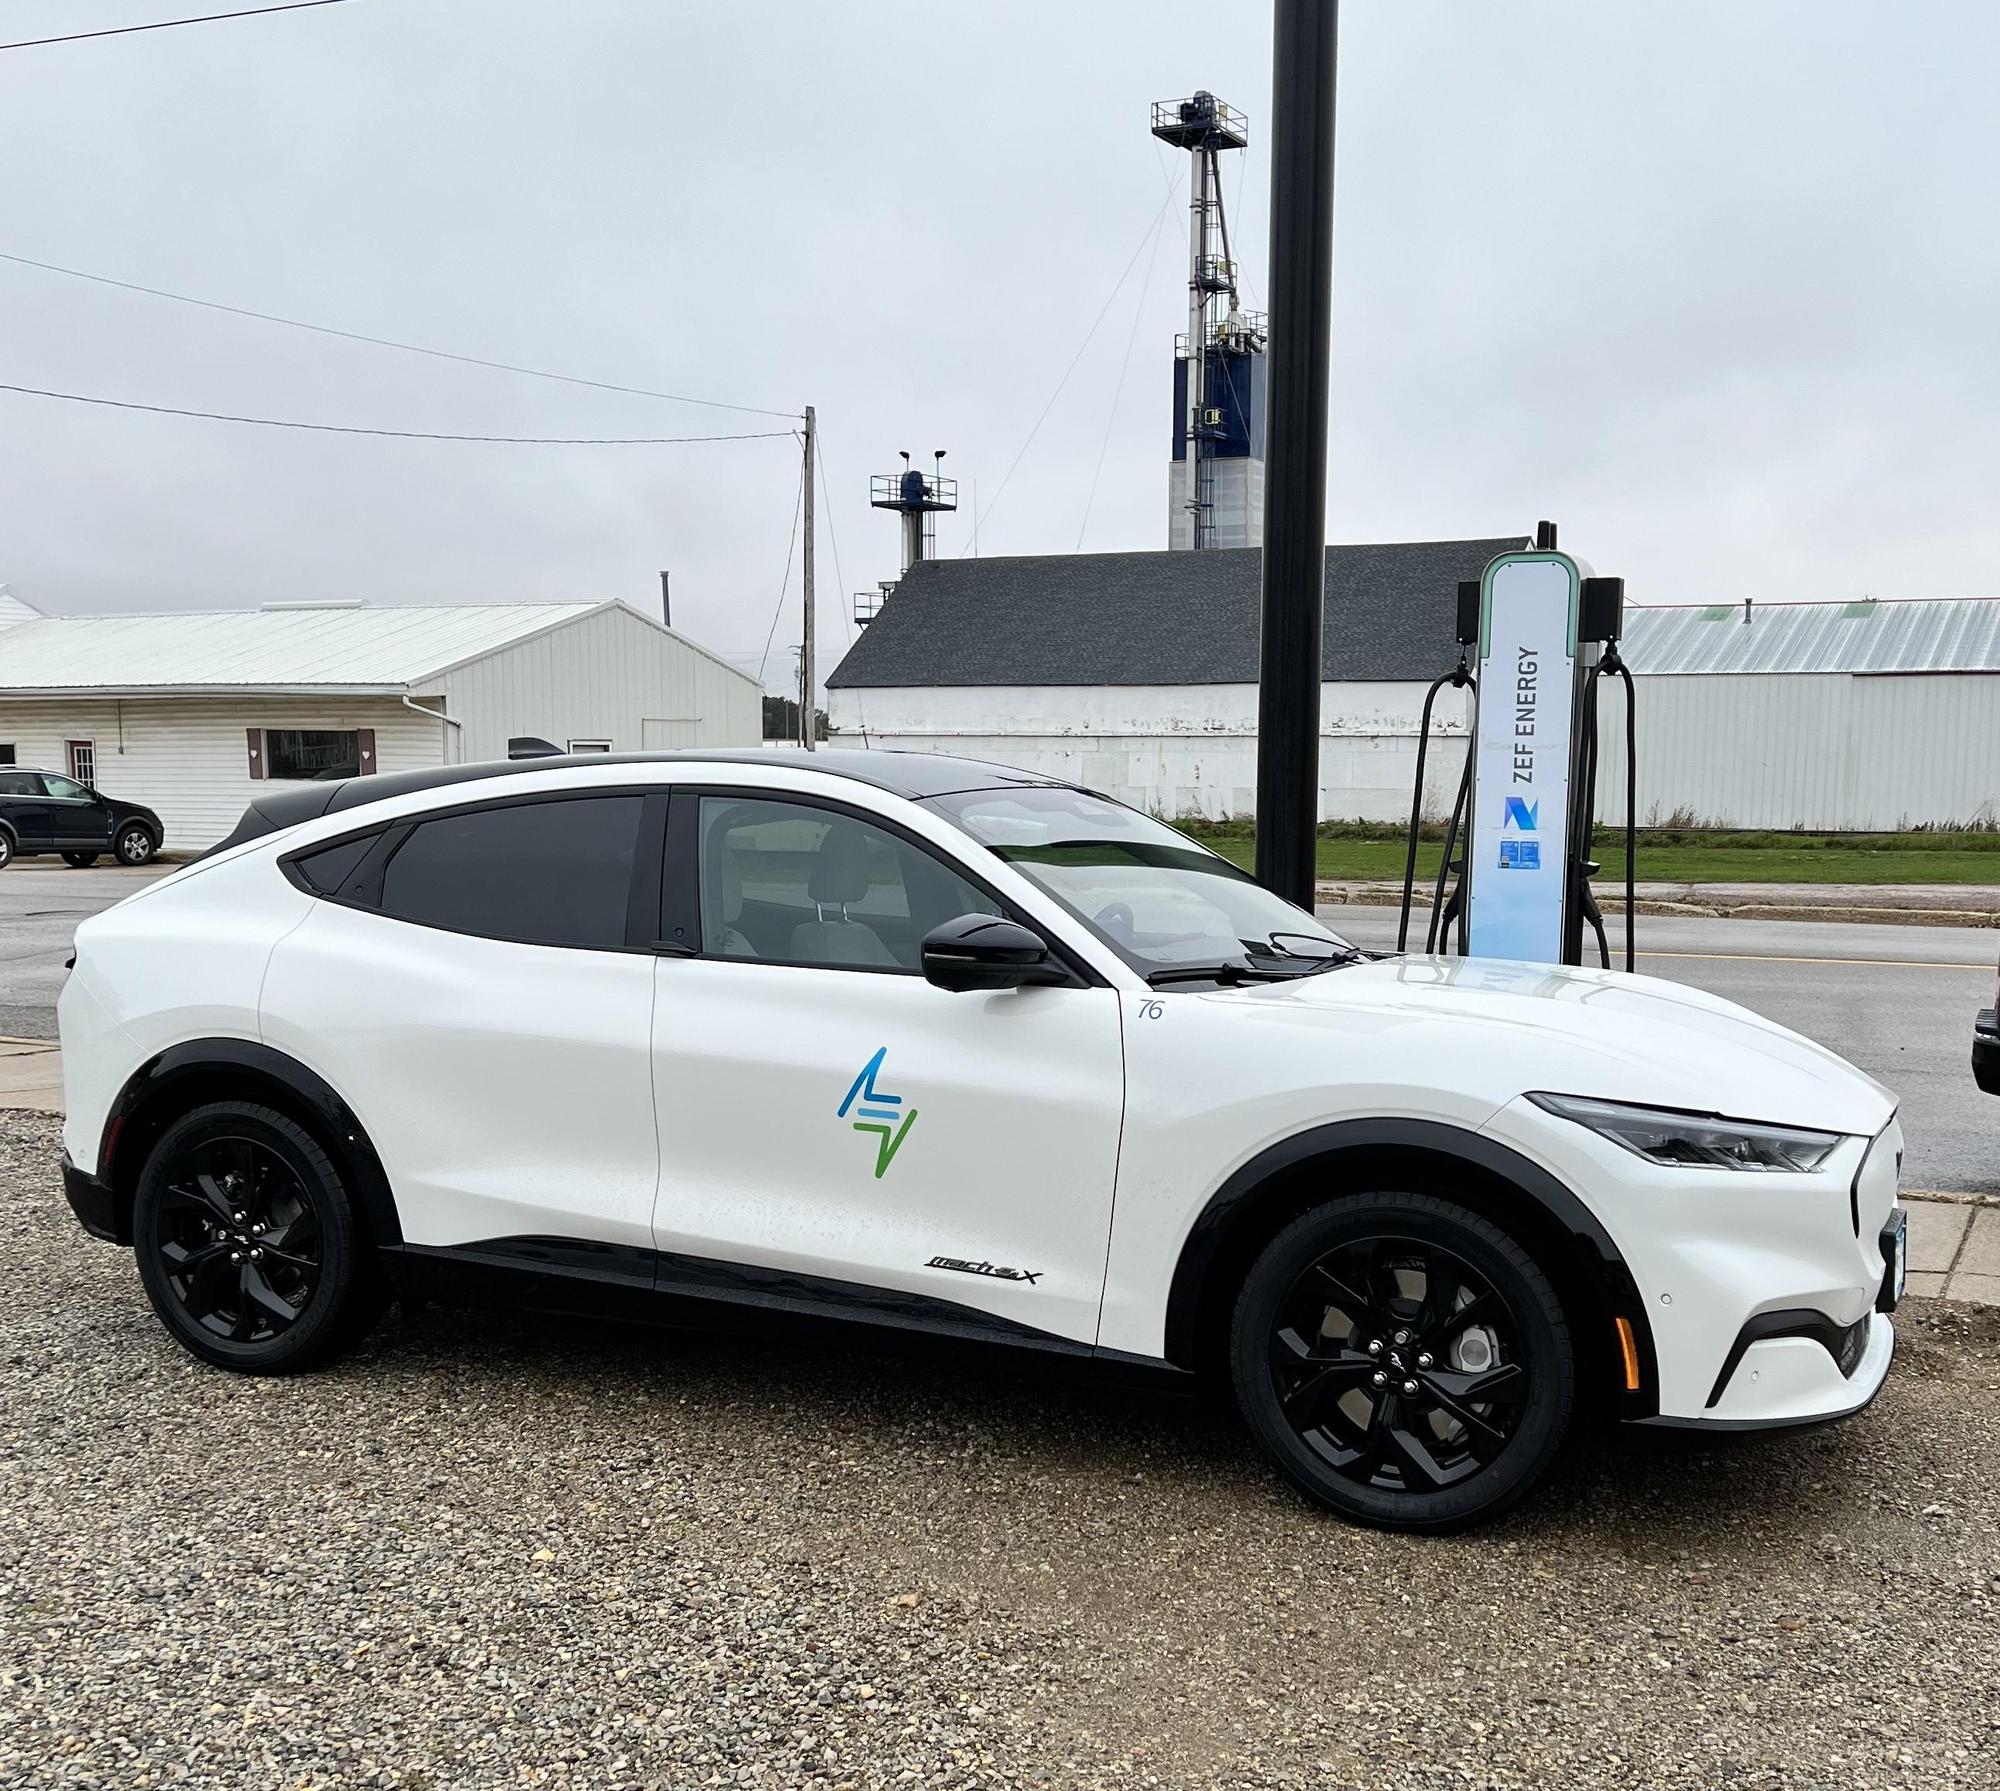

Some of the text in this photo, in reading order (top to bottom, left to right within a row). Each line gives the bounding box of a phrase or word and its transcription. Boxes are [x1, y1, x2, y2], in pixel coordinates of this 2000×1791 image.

[1513, 646, 1538, 784] ZEF ENERGY
[1138, 999, 1166, 1020] 76
